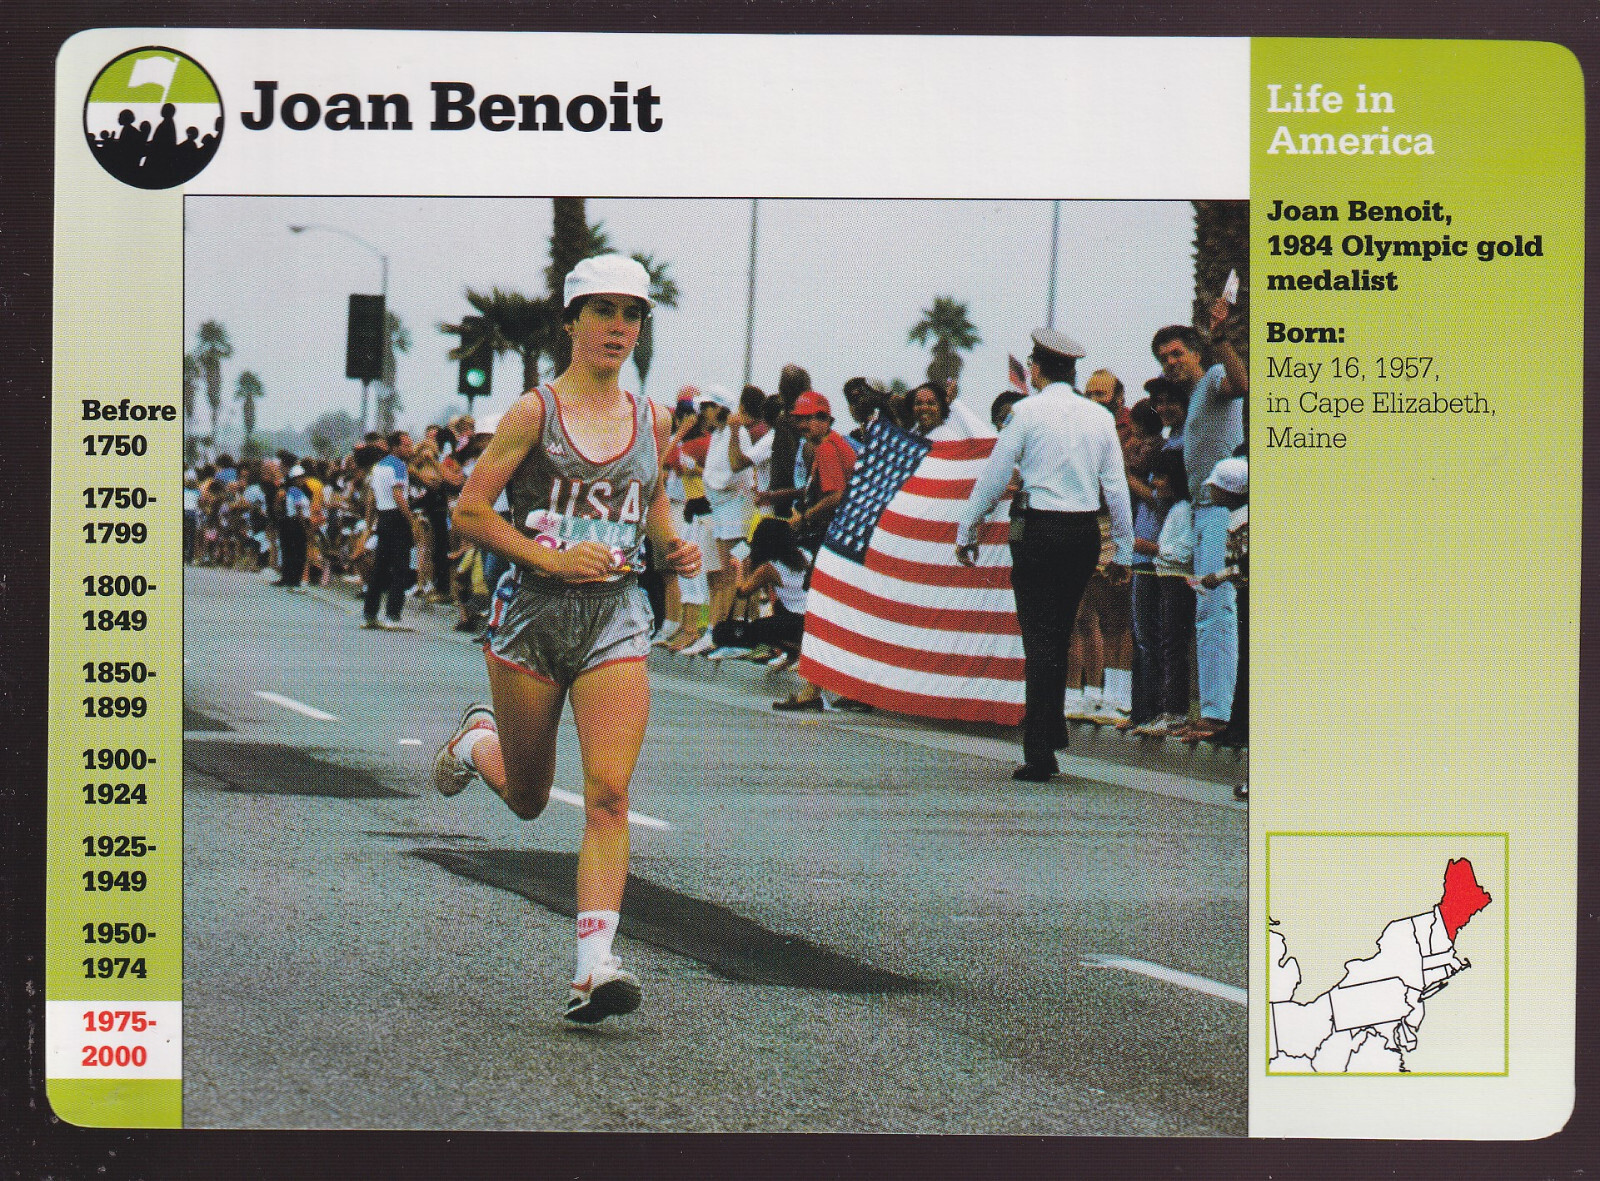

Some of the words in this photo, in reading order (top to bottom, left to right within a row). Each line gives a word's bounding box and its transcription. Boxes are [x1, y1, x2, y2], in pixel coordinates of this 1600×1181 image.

[241, 82, 412, 131] Joan
[430, 81, 663, 134] Benoit
[1268, 85, 1342, 114] Life
[1357, 85, 1395, 113] in
[1267, 127, 1434, 156] America
[1267, 201, 1339, 222] Joan
[1348, 201, 1451, 226] Benoit,
[1269, 236, 1332, 257] 1984
[1342, 236, 1467, 262] Olympic
[1477, 236, 1543, 262] gold
[1268, 270, 1398, 292] medalist
[1267, 323, 1344, 344] Born:
[1267, 356, 1323, 384] May
[1331, 356, 1366, 381] 16,
[1375, 356, 1440, 382] 1957,
[82, 400, 176, 422] Before
[1266, 391, 1291, 413] in
[1299, 391, 1365, 418] Cape
[1372, 391, 1497, 417] Elizabeth,
[83, 436, 147, 457] 1750
[1266, 426, 1347, 449] Maine
[83, 489, 156, 510] 1750-
[548, 477, 642, 524] USA
[83, 524, 147, 544] 1799
[83, 576, 156, 597] 1800-
[83, 611, 147, 632] 1849
[83, 663, 156, 684] 1850-
[83, 698, 147, 719] 1899
[83, 750, 156, 771] 1900-
[83, 784, 147, 805] 1924
[83, 837, 156, 858] 1925-
[83, 872, 147, 893] 1949
[83, 924, 156, 945] 1950-
[83, 958, 147, 979] 1974
[84, 1012, 156, 1032] 1975-
[82, 1047, 146, 1067] 2000
